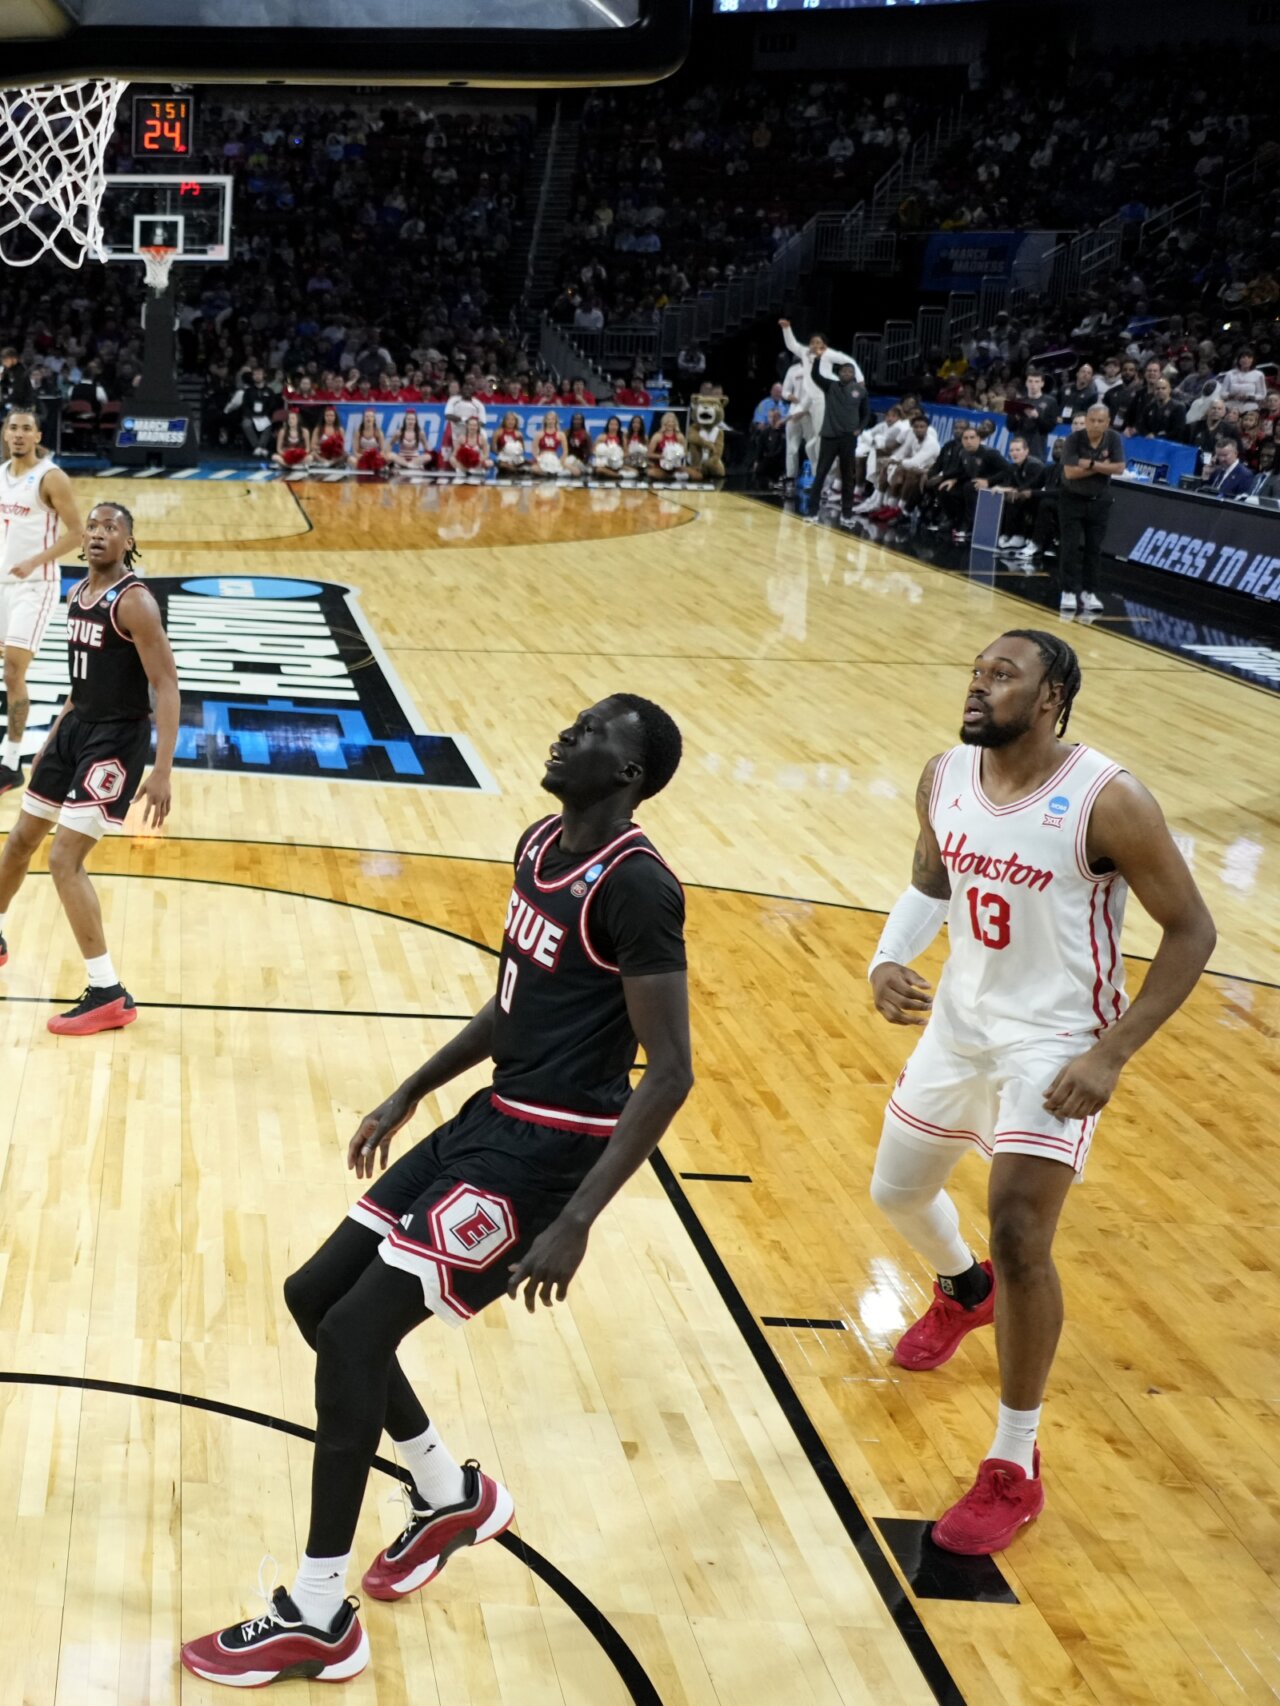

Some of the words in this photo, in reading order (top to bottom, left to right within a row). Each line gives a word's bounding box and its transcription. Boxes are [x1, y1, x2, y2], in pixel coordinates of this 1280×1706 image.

[143, 120, 181, 150] 24
[133, 419, 169, 432] MARCH
[136, 431, 185, 443] MADNESS
[1127, 526, 1217, 579] ACCESS
[1207, 546, 1248, 587] TO
[67, 618, 104, 648] SIUE
[166, 594, 361, 701] MARCH
[72, 651, 88, 680] 11
[97, 768, 120, 793] E
[940, 830, 1054, 893] Houston
[503, 888, 565, 969] SIUE
[966, 886, 1011, 951] 13
[449, 1202, 501, 1251] E
